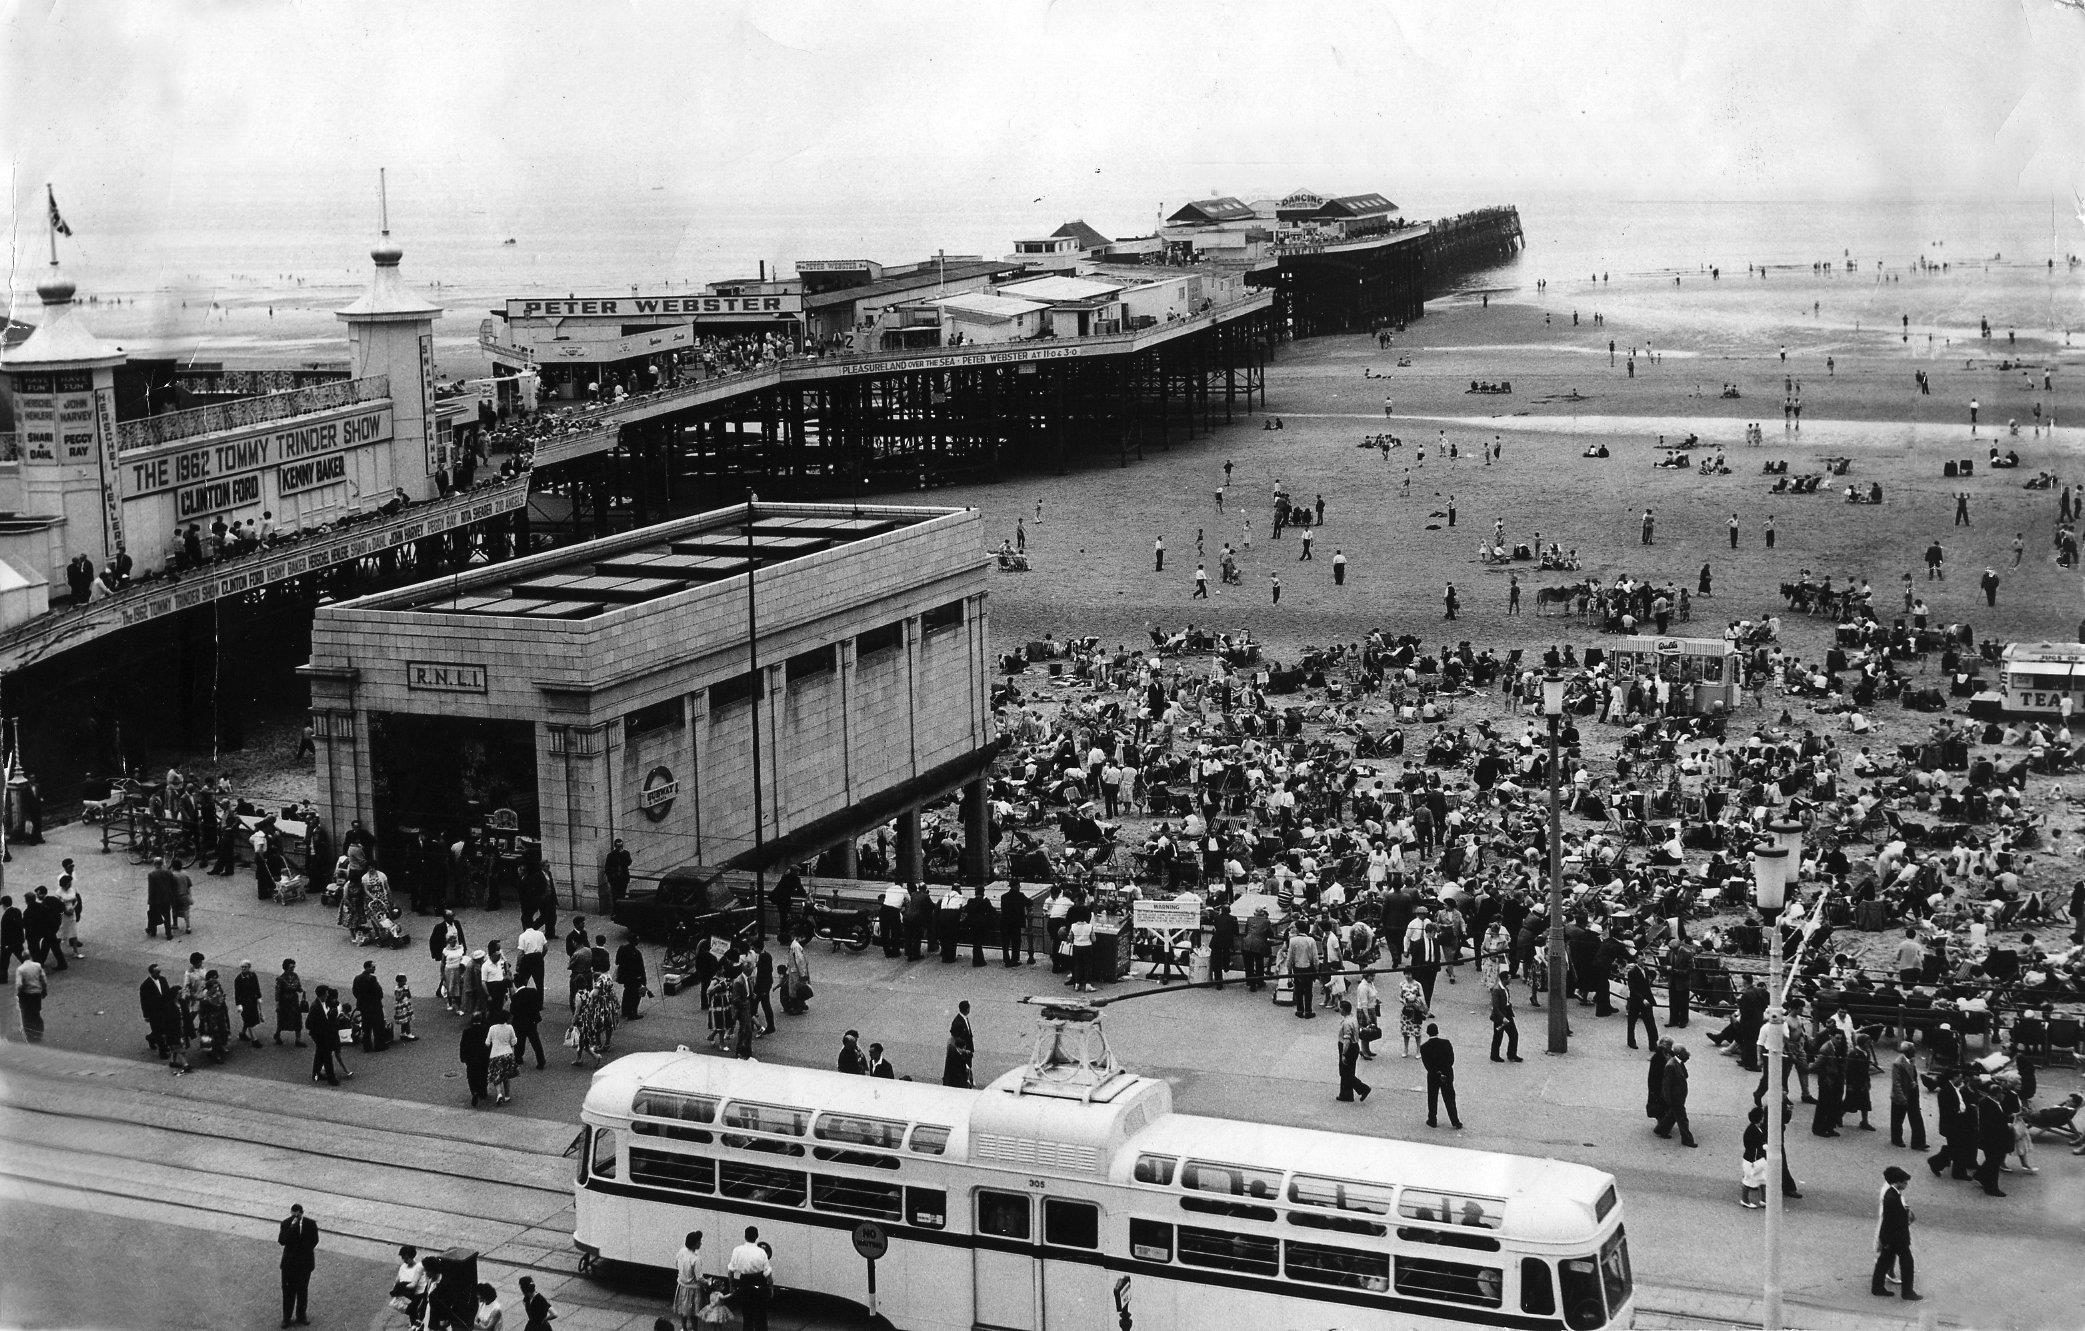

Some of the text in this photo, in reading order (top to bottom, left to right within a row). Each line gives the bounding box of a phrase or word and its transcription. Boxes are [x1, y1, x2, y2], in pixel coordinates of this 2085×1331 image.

[1282, 194, 1323, 206] DANCING
[525, 297, 781, 315] PETER WEBSTER
[842, 358, 907, 375] PLEASURELAND
[908, 360, 924, 369] OVER
[926, 358, 939, 367] THE
[940, 357, 956, 367] SEA
[962, 355, 986, 365] PETER
[990, 350, 1028, 363] WEBSTER
[1031, 351, 1042, 359] AT
[422, 345, 433, 400] SHARI
[63, 382, 85, 390] FUN
[63, 399, 88, 409] JOHN
[60, 411, 92, 422] HARVEY
[27, 432, 54, 443] SHARI
[98, 392, 119, 470] HERSCHEL
[29, 449, 54, 460] DAHL
[68, 446, 88, 457] RAY
[133, 414, 380, 491] THE 1962 TOMMY TRINDER SHOW
[281, 456, 345, 491] KENNY BAKER
[180, 475, 259, 516] CLINTON FORD
[149, 598, 172, 617] TOMMY
[221, 575, 247, 596] CLINTON
[248, 569, 264, 588] FORD
[389, 528, 403, 547] JOHN
[404, 522, 423, 542] HARVEY
[416, 667, 481, 687] R.N.L.I.
[2001, 660, 2009, 698] TEA
[2020, 692, 2061, 707] TEA
[647, 783, 675, 801] SUBWAY
[1029, 1179, 1045, 1188] 305
[862, 1228, 877, 1239] NO
